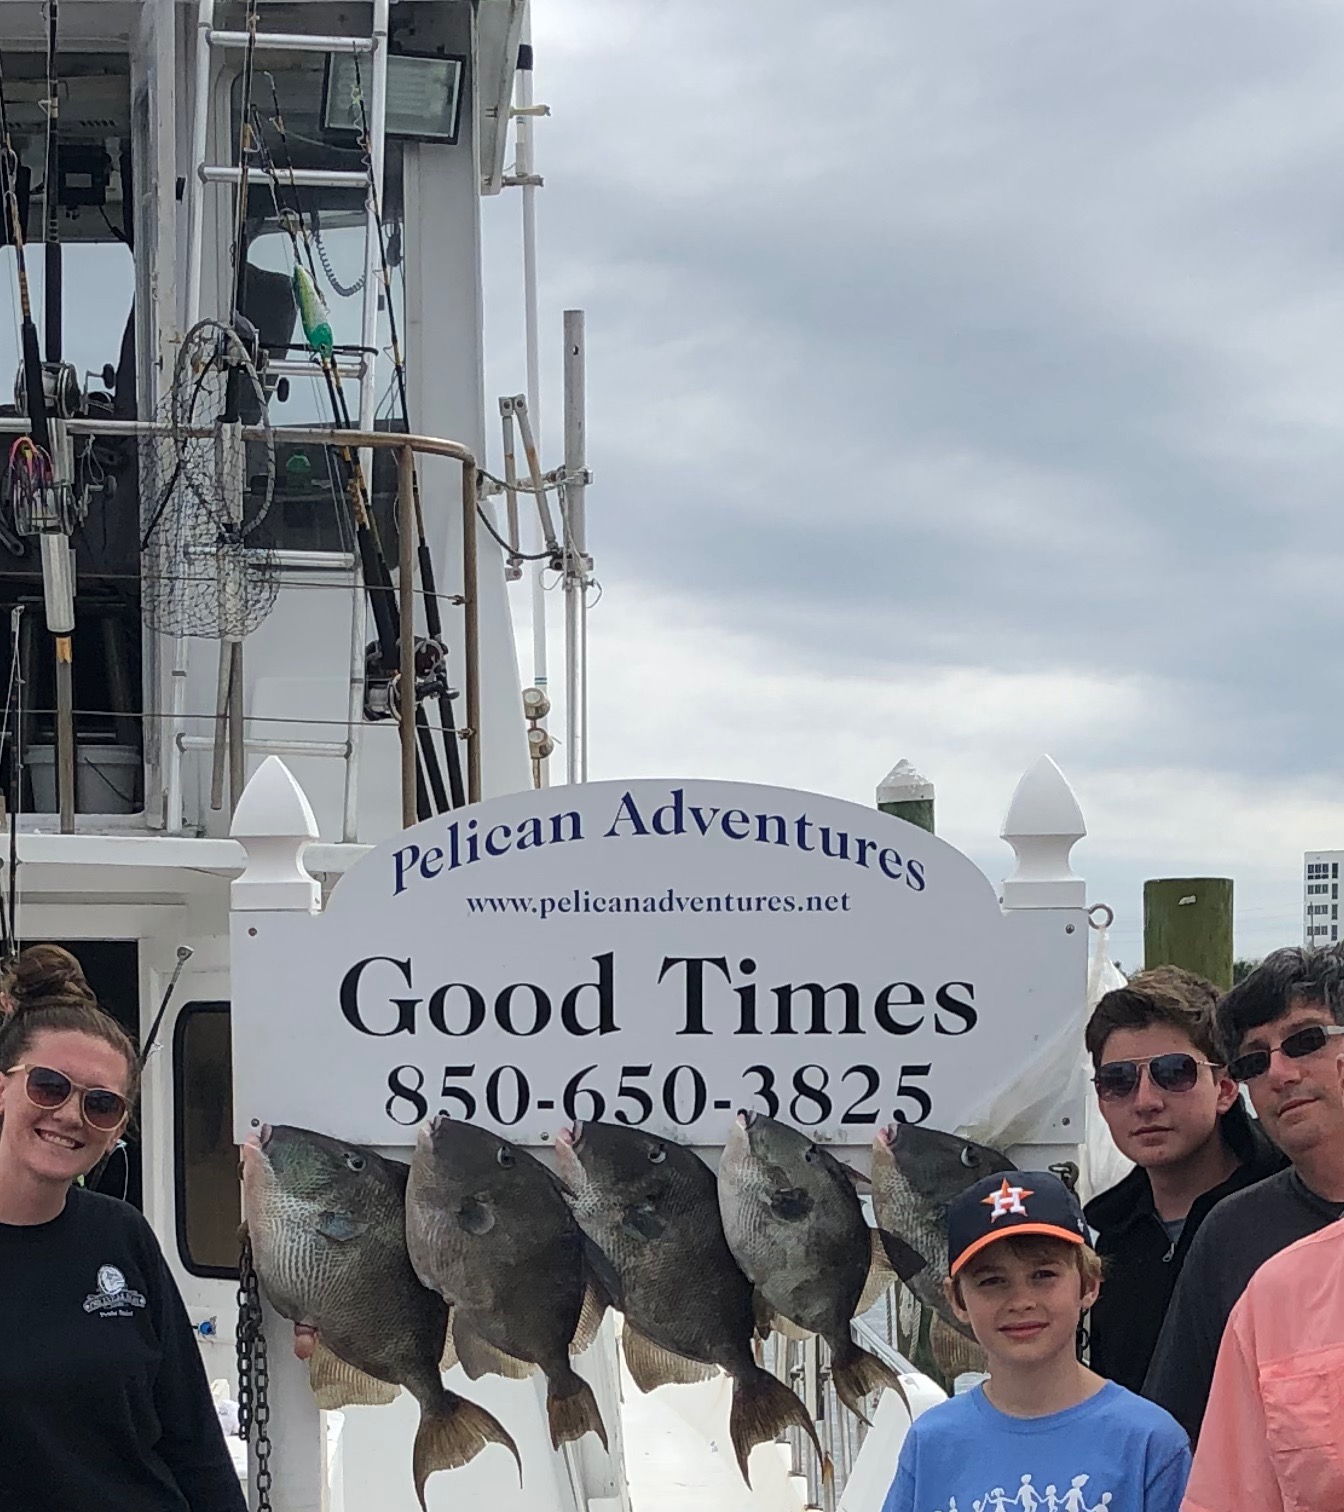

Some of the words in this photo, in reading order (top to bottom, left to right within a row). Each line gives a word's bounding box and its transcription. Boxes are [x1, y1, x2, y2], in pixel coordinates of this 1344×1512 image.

[392, 811, 585, 897] Pelican
[603, 788, 929, 893] Adventures
[466, 889, 852, 918] www.pelicanadventures.net
[340, 952, 621, 1037] Good
[658, 956, 978, 1036] Times
[385, 1062, 933, 1126] 850-650-3825
